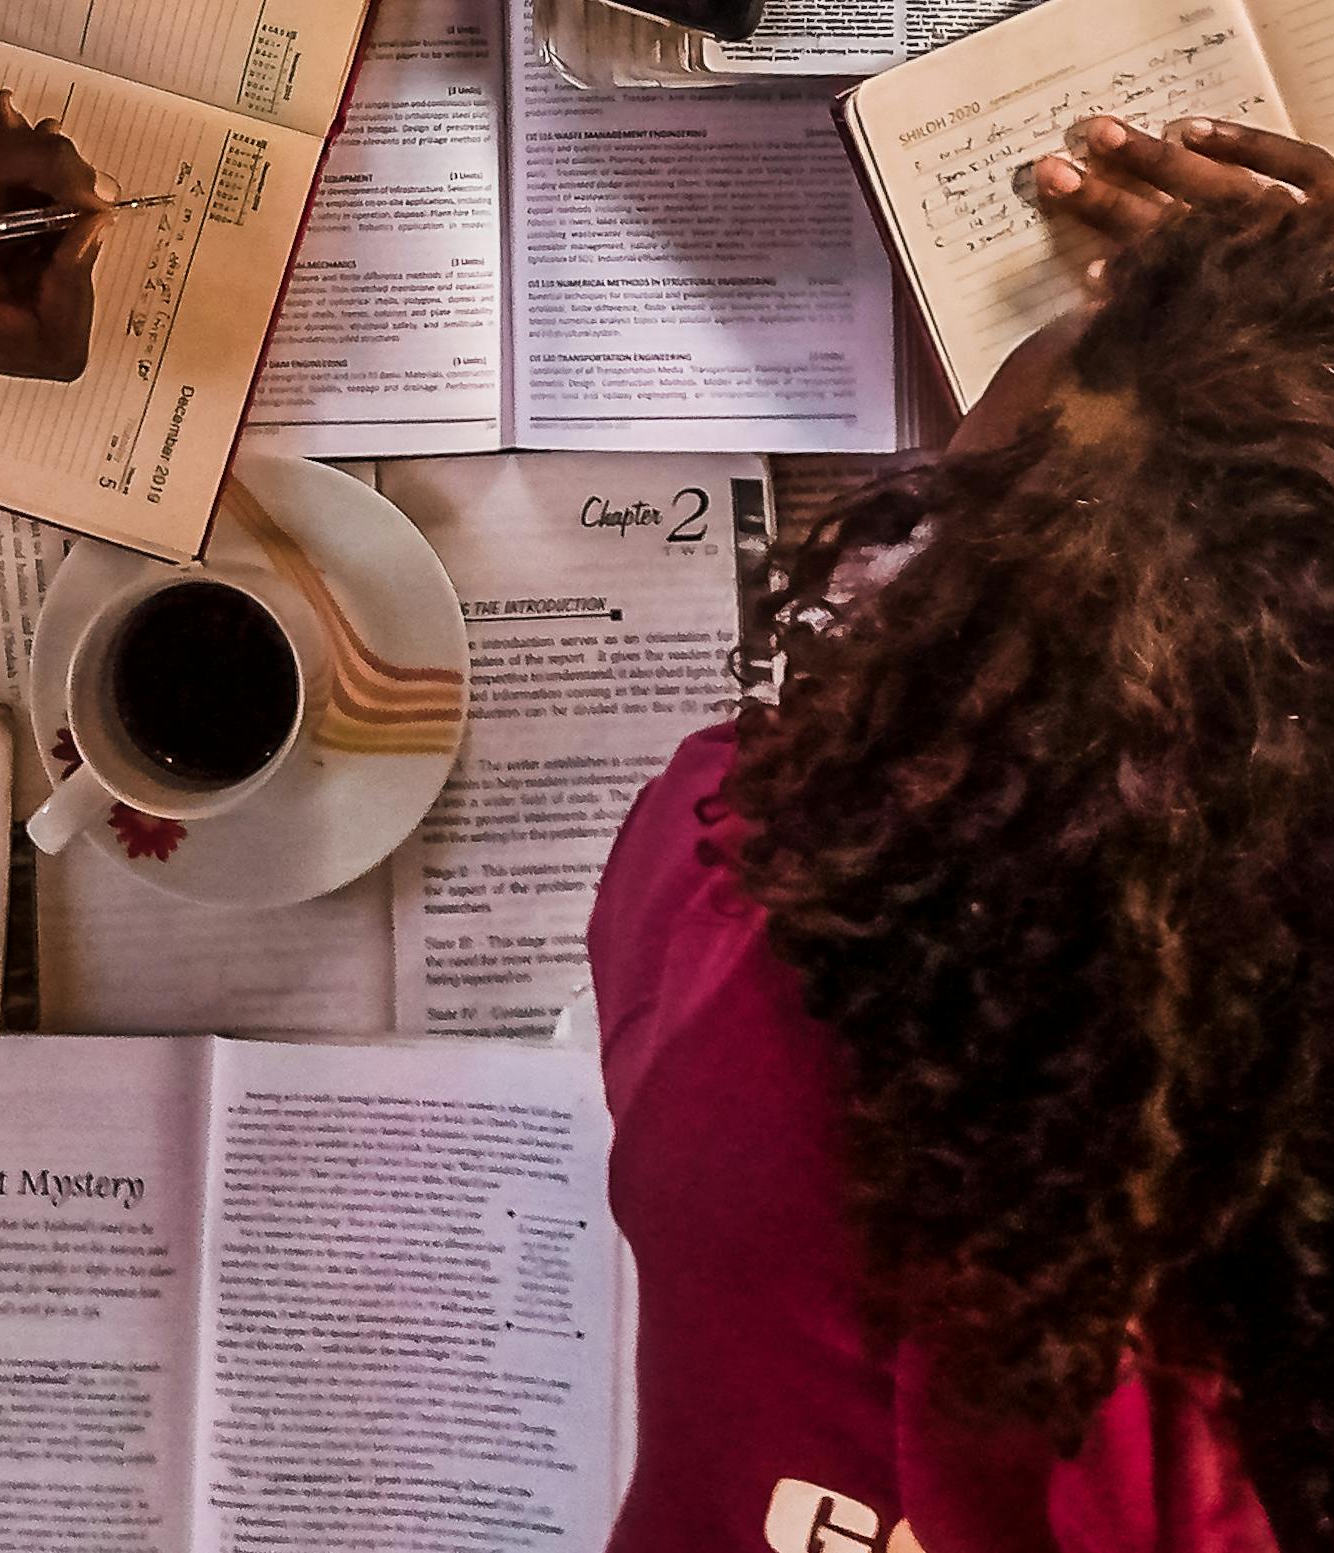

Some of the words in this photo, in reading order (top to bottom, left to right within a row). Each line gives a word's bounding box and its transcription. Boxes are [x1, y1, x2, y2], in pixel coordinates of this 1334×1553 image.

[898, 117, 948, 148] SHILOH
[947, 100, 982, 129] 2020
[583, 130, 647, 139] MANAGEMENT
[649, 128, 708, 139] ENGINEERING
[323, 173, 374, 184] EQUIPMENT
[557, 279, 606, 288] NUMERICAL
[607, 278, 650, 287] METHODS
[662, 277, 716, 287] STRUCTURAL
[558, 354, 632, 363] TRANSPORTATION
[634, 353, 692, 362] ENGINEERING
[162, 384, 195, 466] December
[99, 476, 118, 490] 5
[146, 466, 170, 505] 2019
[581, 495, 663, 538] Chapter
[665, 486, 711, 544] 2
[475, 600, 500, 616] THE
[504, 597, 607, 614] INTRODUCTION
[482, 638, 555, 650] introduction
[561, 636, 599, 646] serves
[605, 634, 618, 644] as
[19, 1169, 146, 1209] Mystery
